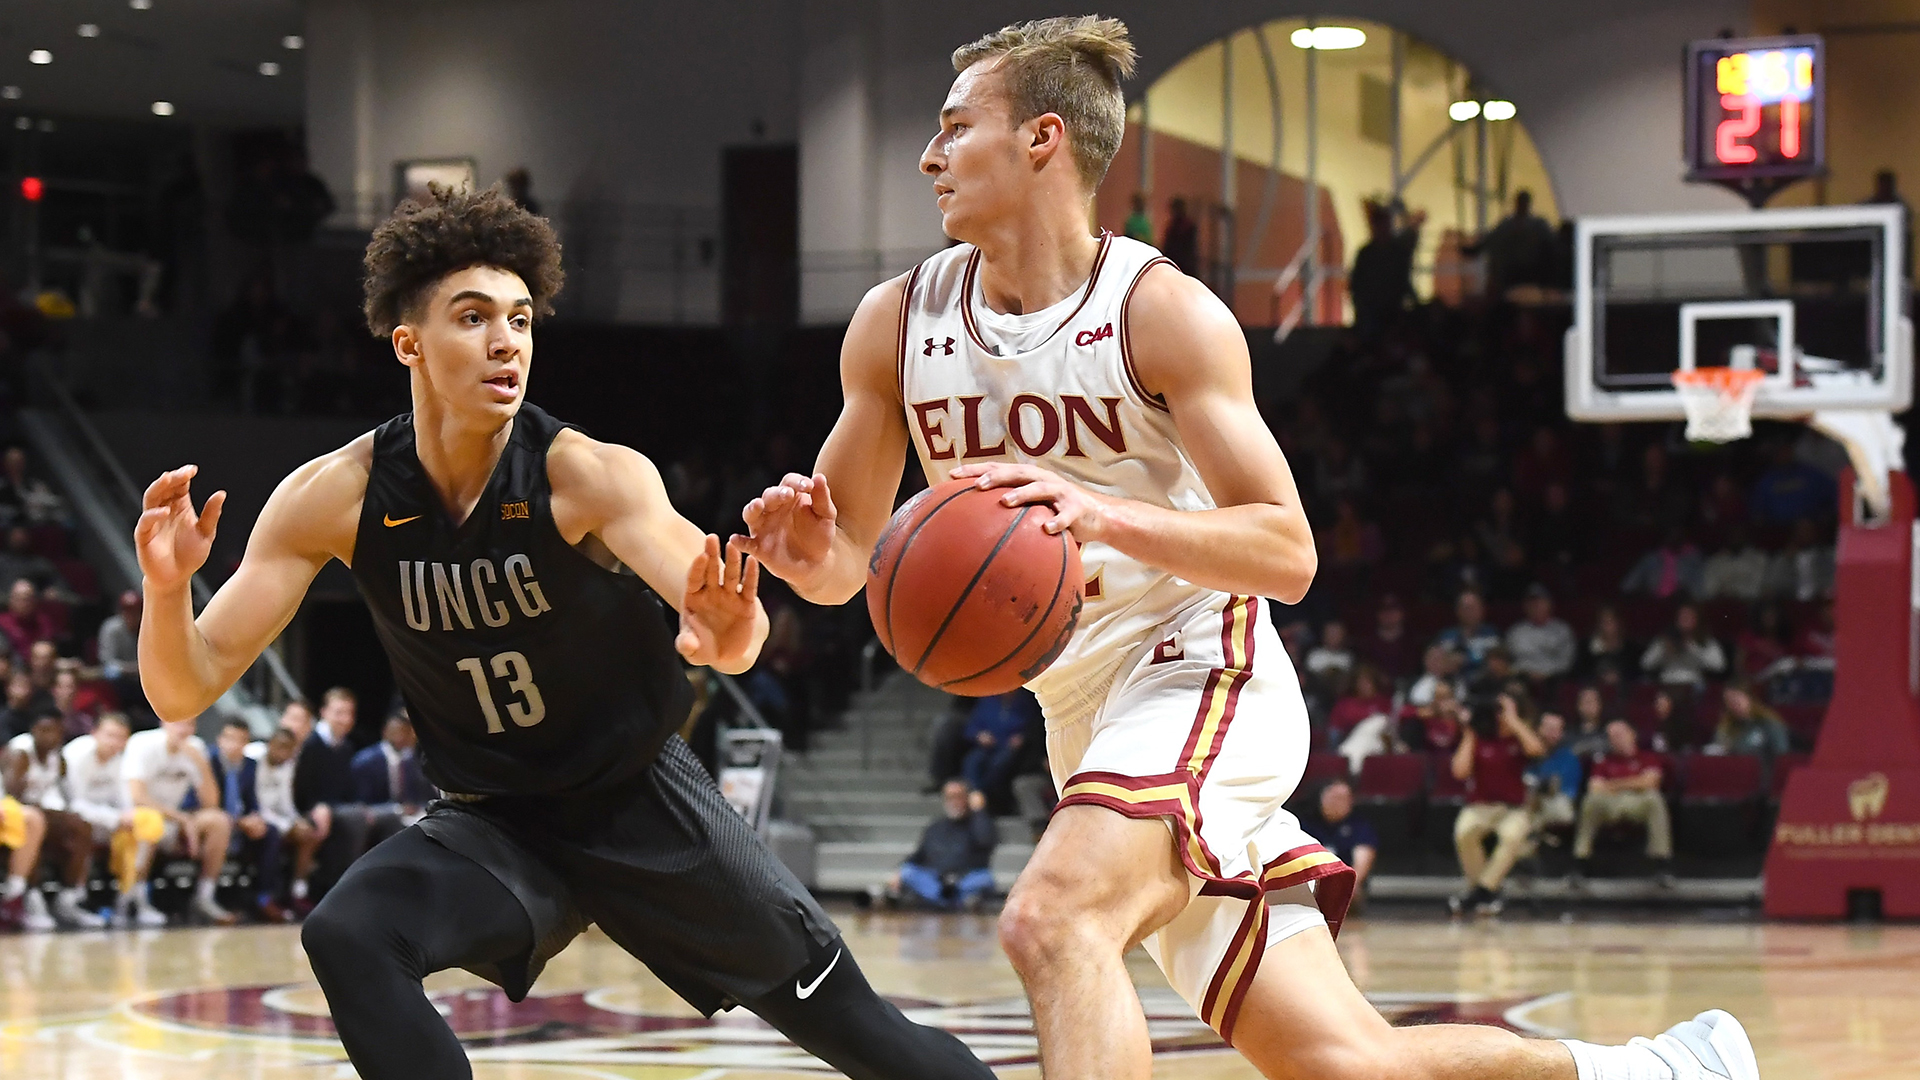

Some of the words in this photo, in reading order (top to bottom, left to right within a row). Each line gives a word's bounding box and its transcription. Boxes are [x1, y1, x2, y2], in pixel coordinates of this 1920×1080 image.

[1716, 93, 1801, 164] 21
[1075, 322, 1114, 347] CAA
[909, 391, 1128, 461] ELON
[501, 500, 530, 520] SOCON
[398, 553, 552, 632] UNCG
[1149, 630, 1185, 666] E
[455, 650, 546, 734] 13
